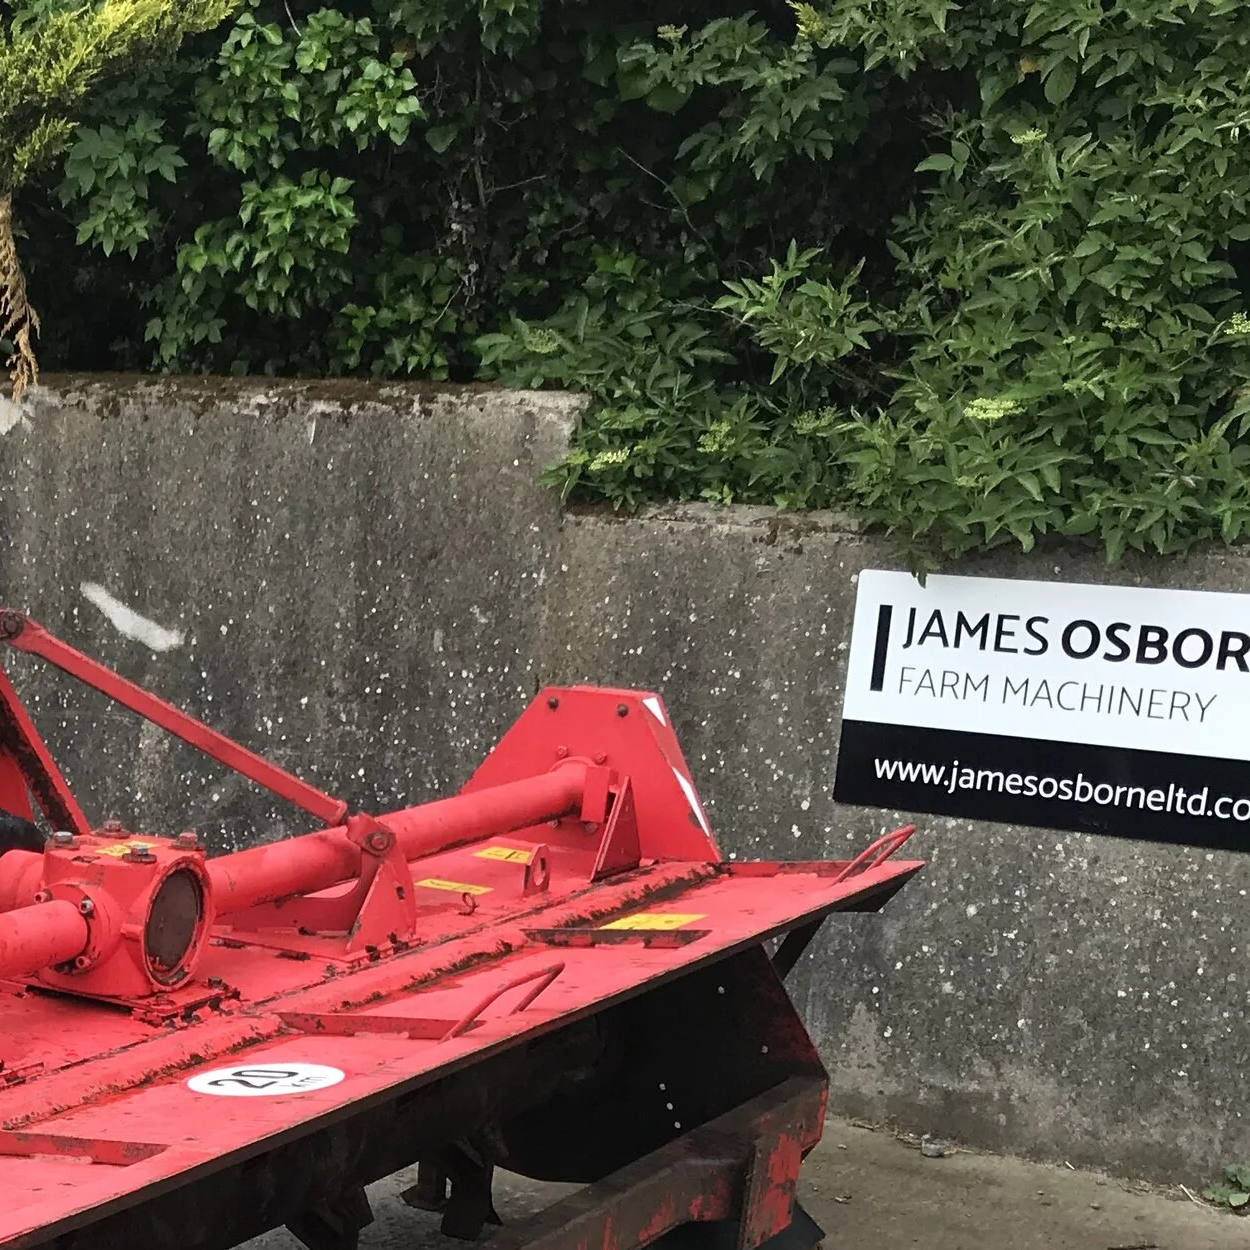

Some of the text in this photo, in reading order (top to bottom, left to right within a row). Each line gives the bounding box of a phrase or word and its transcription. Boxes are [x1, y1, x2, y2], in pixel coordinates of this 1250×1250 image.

[902, 607, 1250, 673] JAMES OSBOR
[898, 667, 1218, 723] FARM MACHINERY
[874, 757, 1250, 821] www.jamesosborneltd.co
[207, 1069, 299, 1089] 20
